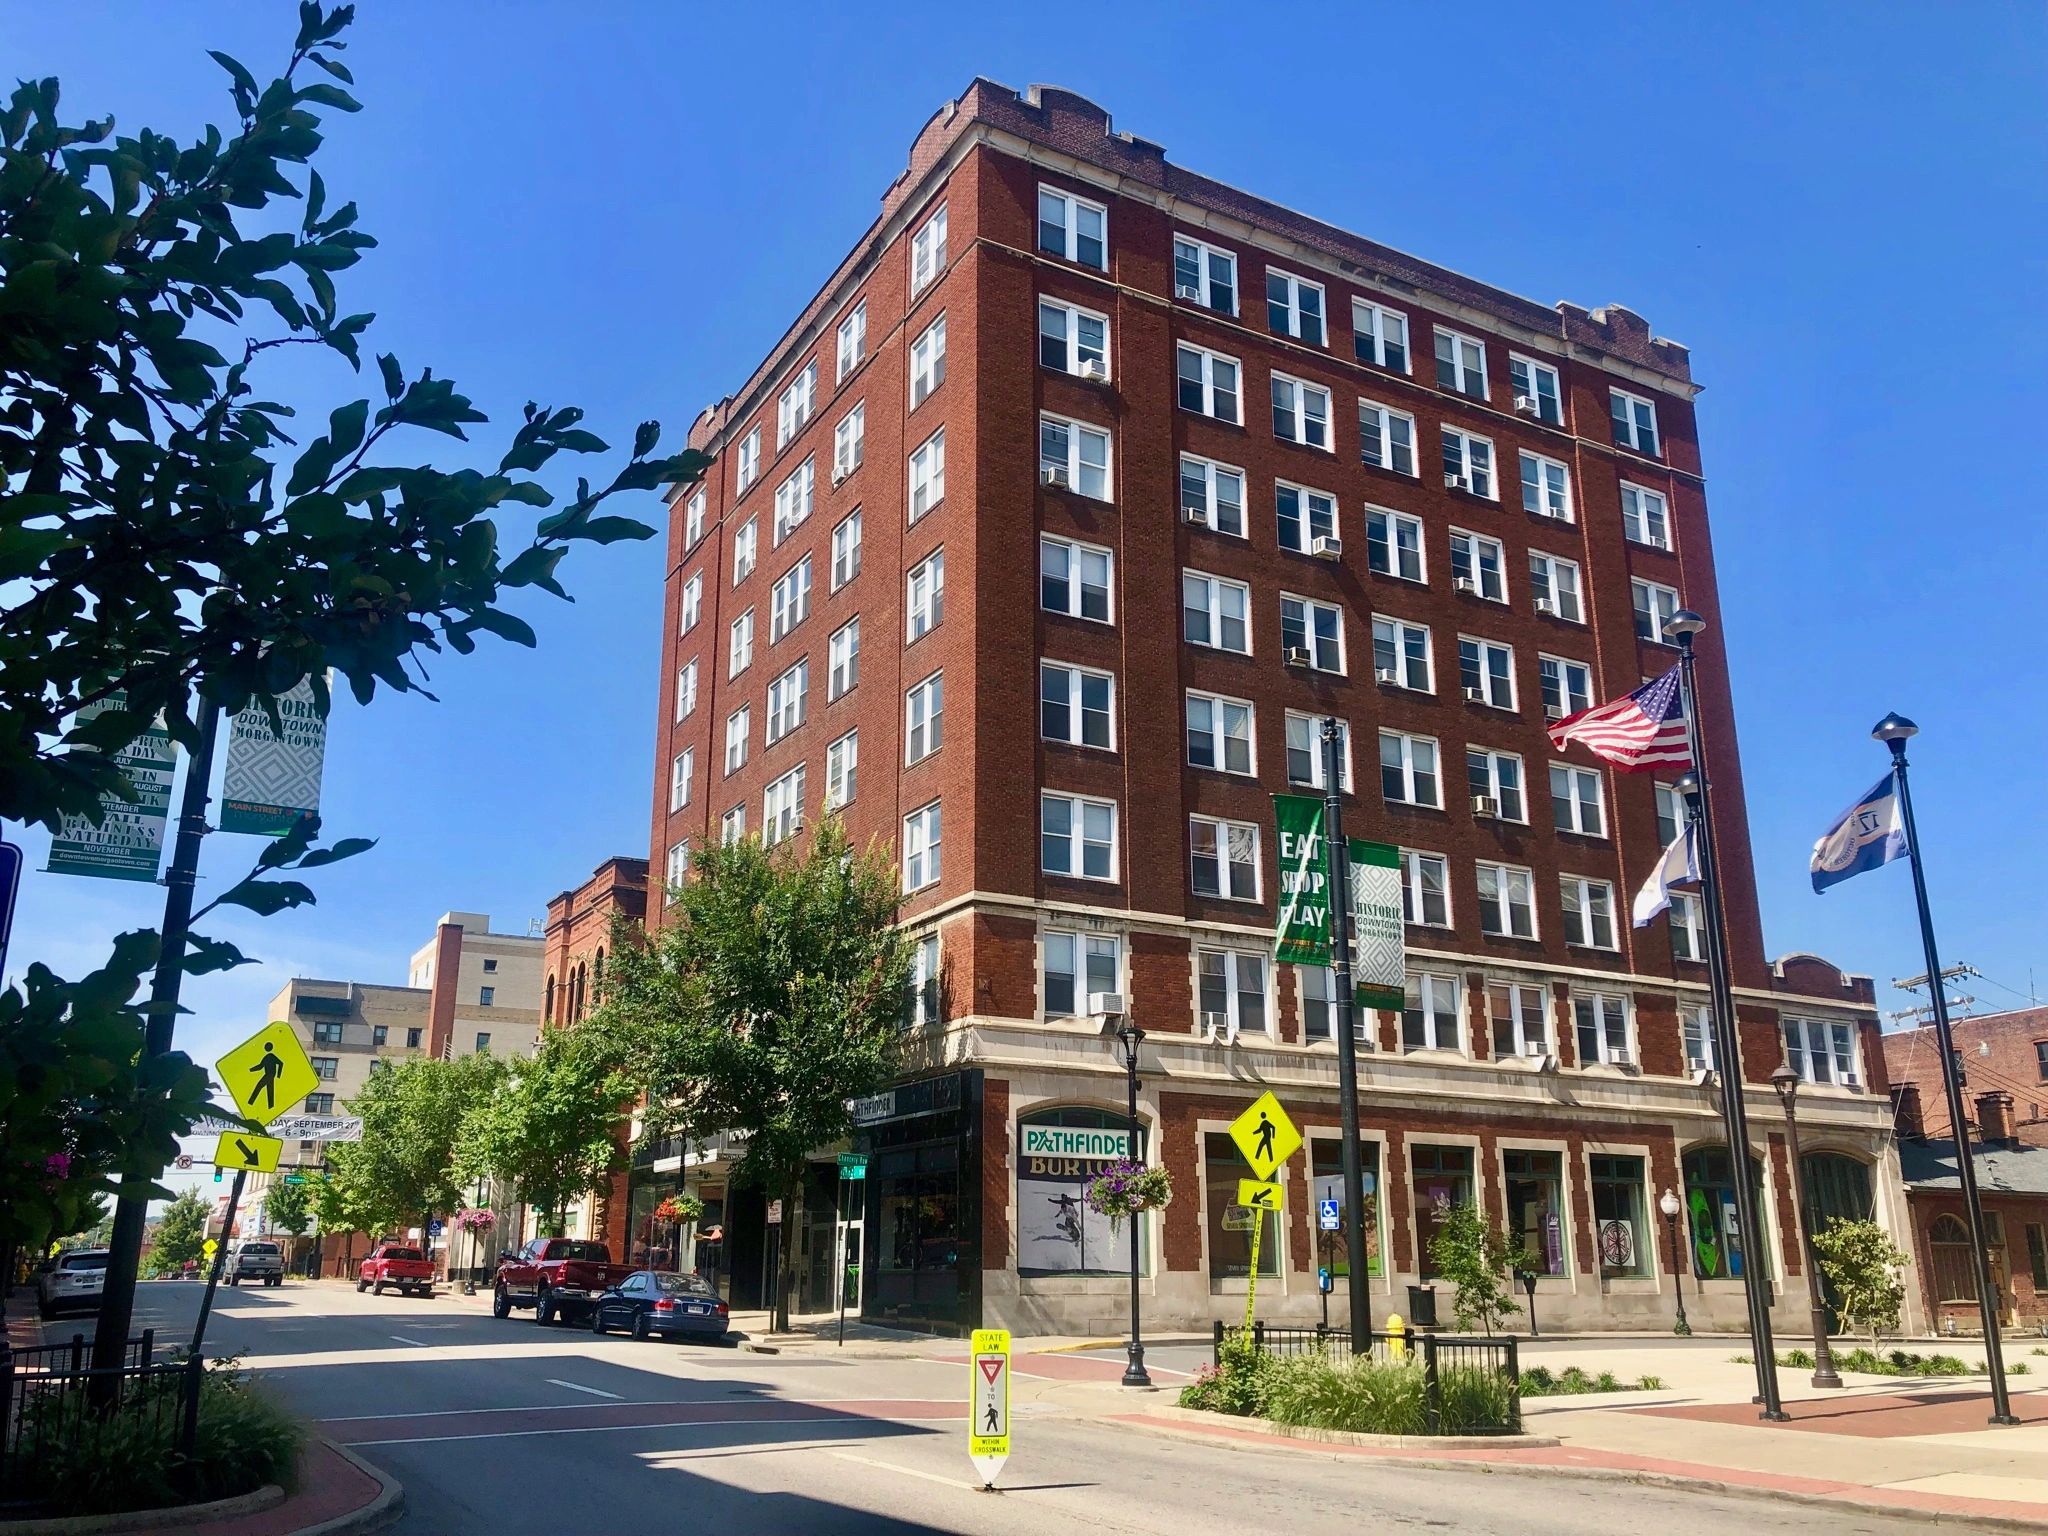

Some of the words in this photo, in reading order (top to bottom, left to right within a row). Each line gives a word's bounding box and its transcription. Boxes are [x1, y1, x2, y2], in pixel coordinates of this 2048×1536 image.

[238, 713, 322, 734] DOWTOWN
[132, 746, 155, 758] DAY
[114, 757, 132, 765] JULY
[142, 771, 157, 782] IN
[133, 782, 163, 792] AUGUST
[227, 802, 251, 812] MAIN
[253, 805, 282, 815] STREET
[65, 818, 155, 837] BUINESS
[63, 829, 154, 849] SATURDAY
[83, 844, 131, 856] NOVEMBER
[1280, 832, 1322, 860] EAT
[59, 852, 151, 867] downtownmorgantown.com
[1282, 871, 1325, 894] SHOP
[1356, 902, 1401, 920] HISTORIC
[1357, 917, 1401, 931] DOWNTOWN
[1357, 927, 1402, 940] MORGANTOWN
[853, 1097, 891, 1117] ATHFINDER
[269, 1119, 291, 1129] DAY,
[294, 1120, 344, 1129] SEPTEMBER
[299, 1130, 321, 1138] 9pm
[1028, 1129, 1131, 1155] PATHFINDE
[1030, 1158, 1117, 1176] BURTO
[1253, 1220, 1261, 1248] YIELD
[1252, 1256, 1258, 1268] TO
[980, 1334, 1003, 1342] STATE
[983, 1343, 999, 1351] LAW
